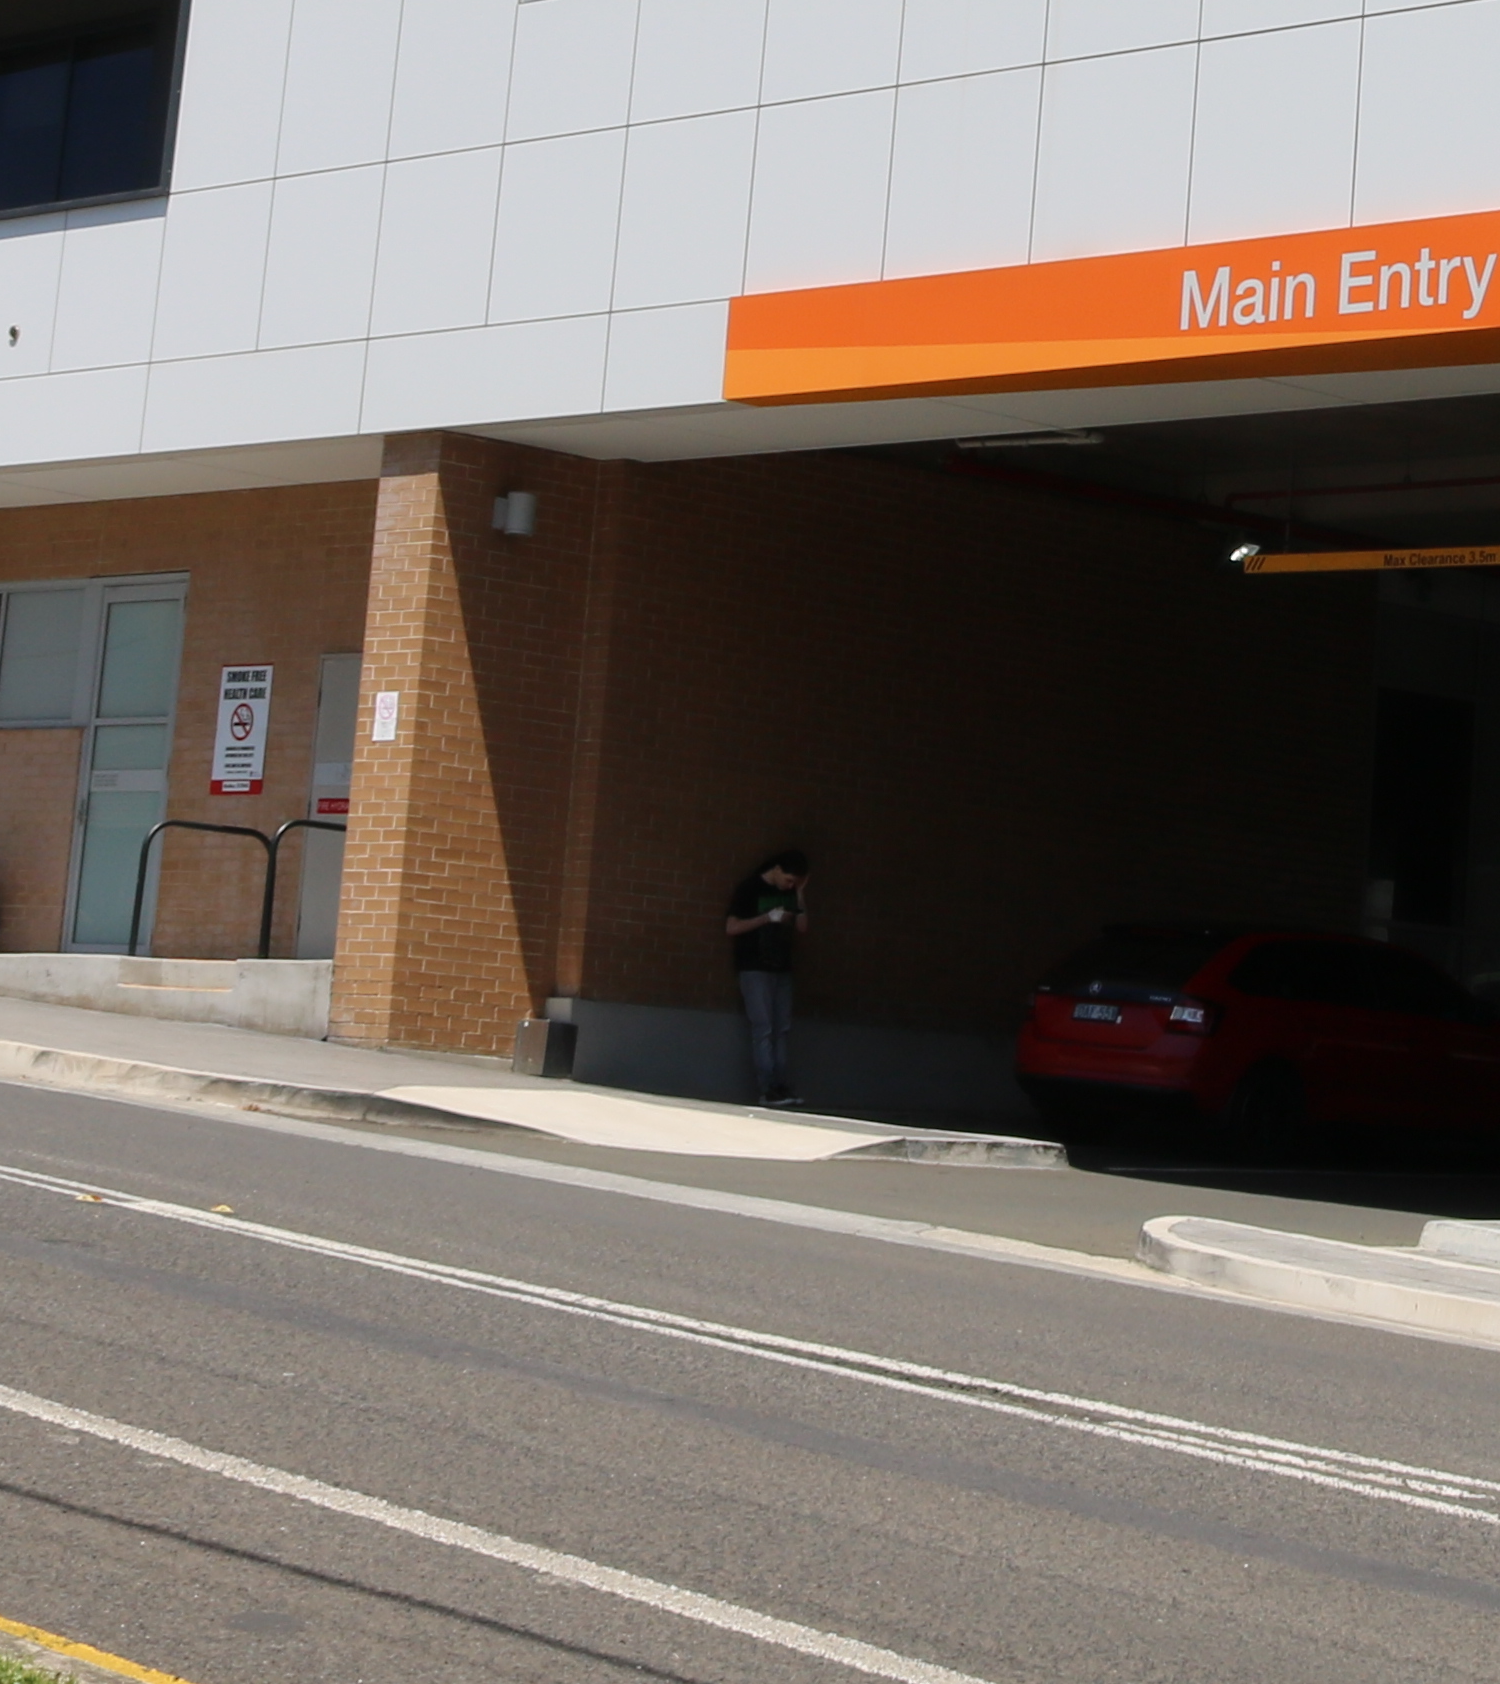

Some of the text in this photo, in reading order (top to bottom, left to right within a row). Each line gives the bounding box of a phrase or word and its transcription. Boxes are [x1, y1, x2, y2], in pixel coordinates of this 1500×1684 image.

[1180, 247, 1498, 331] Main Entry
[1384, 554, 1406, 566] Max
[1409, 552, 1466, 565] Clearance
